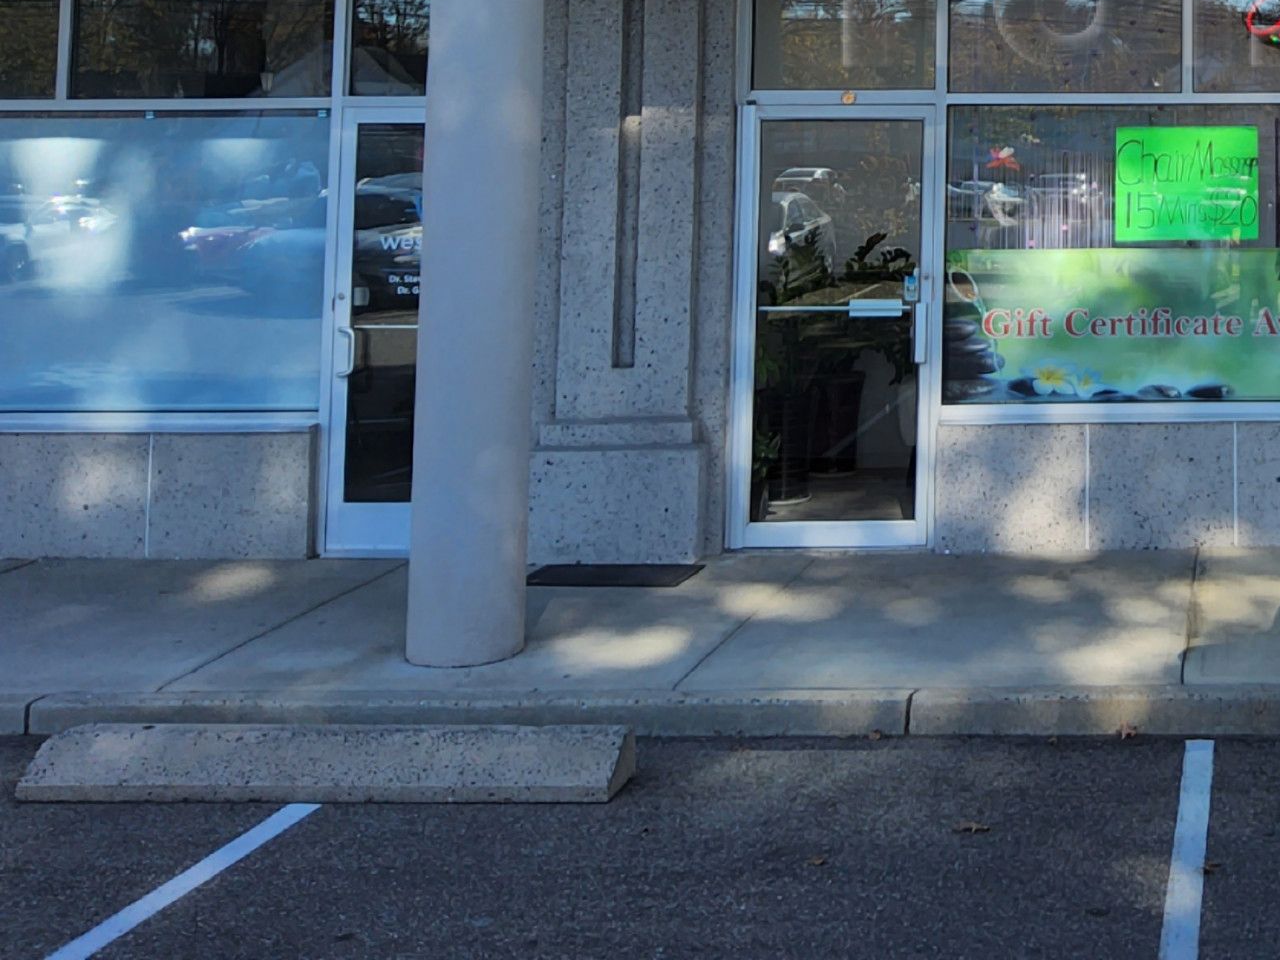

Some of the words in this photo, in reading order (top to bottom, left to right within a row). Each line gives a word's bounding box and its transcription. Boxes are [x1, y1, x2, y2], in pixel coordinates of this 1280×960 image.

[1117, 139, 1187, 186] Chair
[1126, 192, 1155, 229] 15
[981, 307, 1052, 338] Gift
[1062, 307, 1244, 337] Certificate
